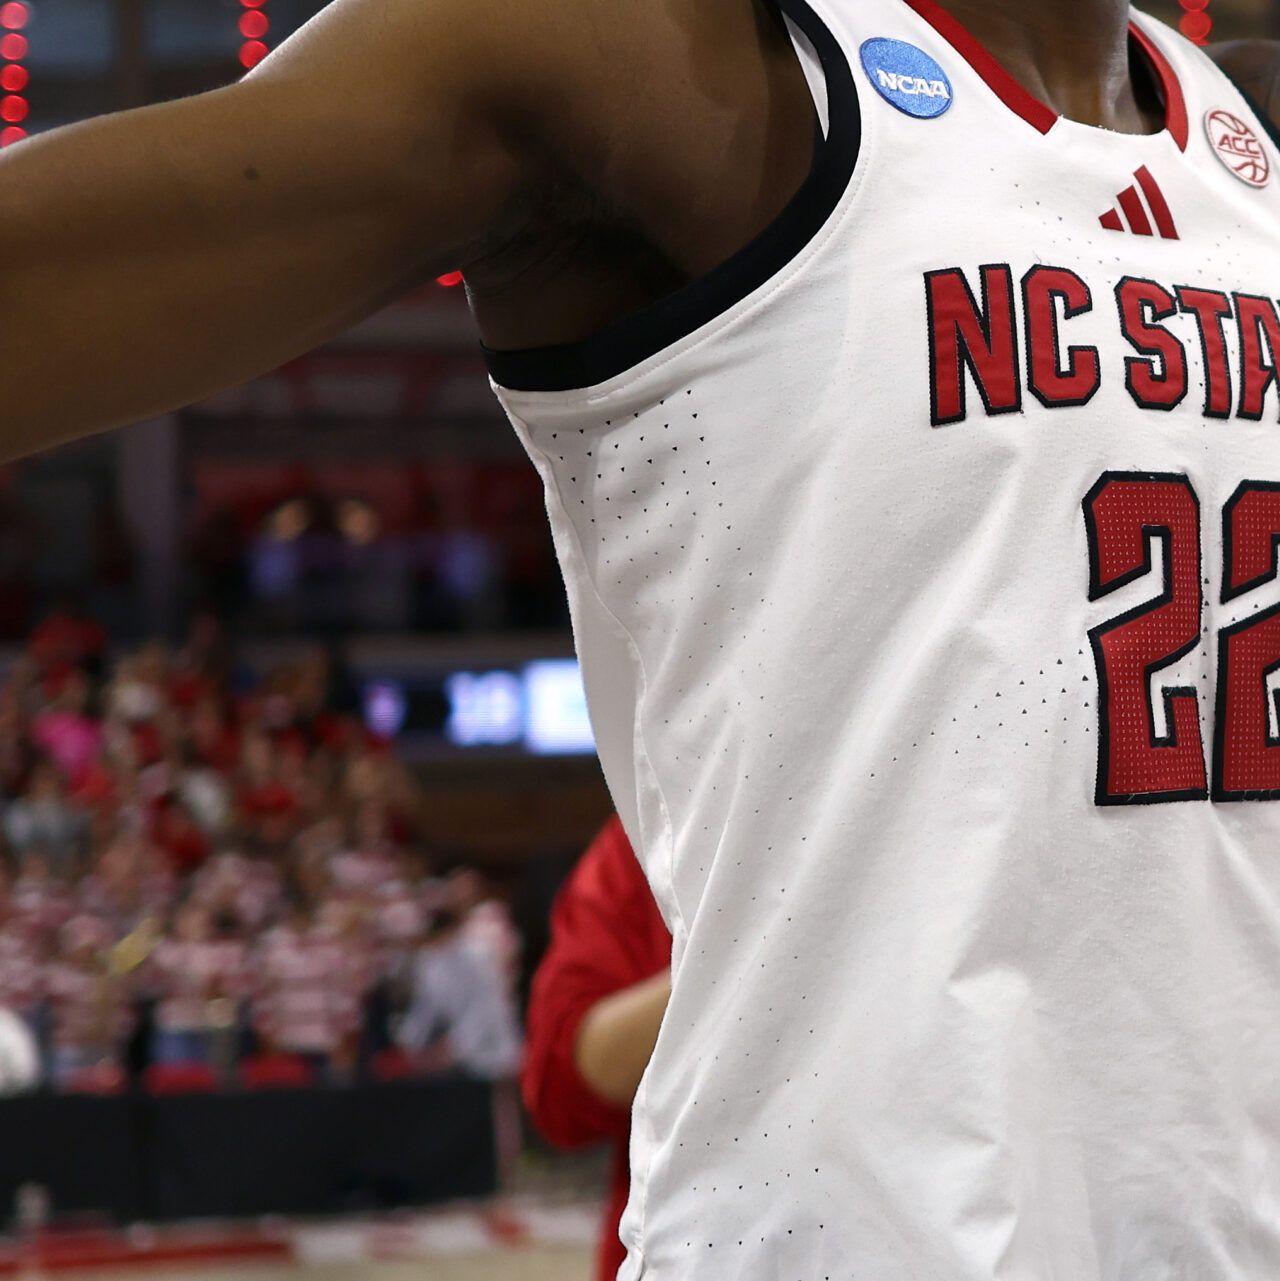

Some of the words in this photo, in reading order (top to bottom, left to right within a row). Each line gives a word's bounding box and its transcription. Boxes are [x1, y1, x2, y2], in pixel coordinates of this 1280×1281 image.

[876, 68, 950, 99] NCAA
[1220, 134, 1260, 154] ACC
[923, 263, 1101, 427] NC
